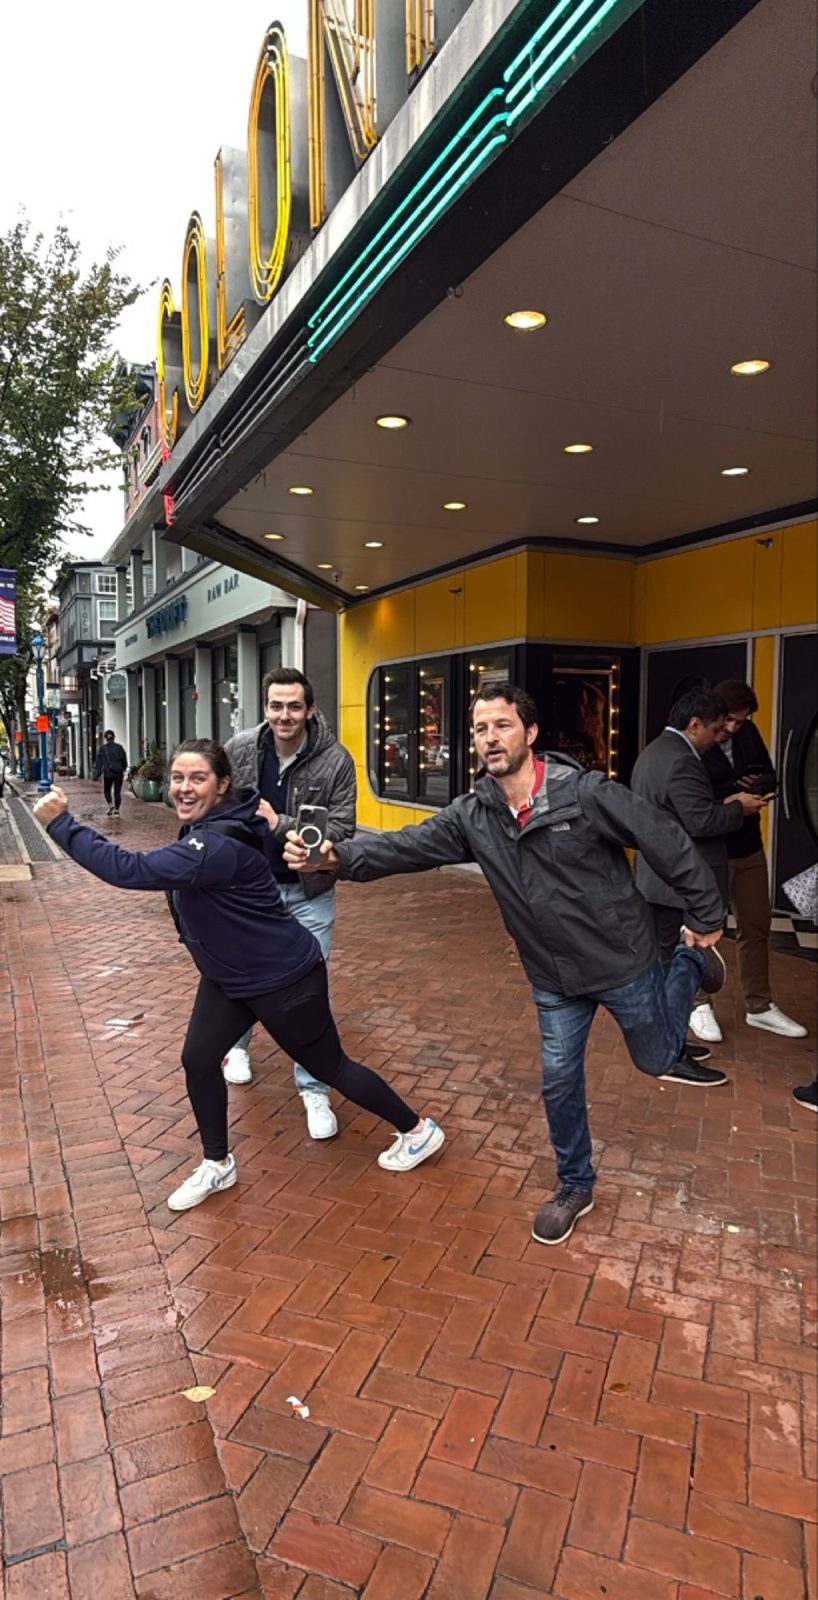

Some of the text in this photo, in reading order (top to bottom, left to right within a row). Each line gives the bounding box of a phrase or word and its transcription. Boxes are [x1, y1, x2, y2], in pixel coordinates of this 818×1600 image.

[157, 0, 435, 448] COLON
[207, 573, 240, 604] RAW BAR
